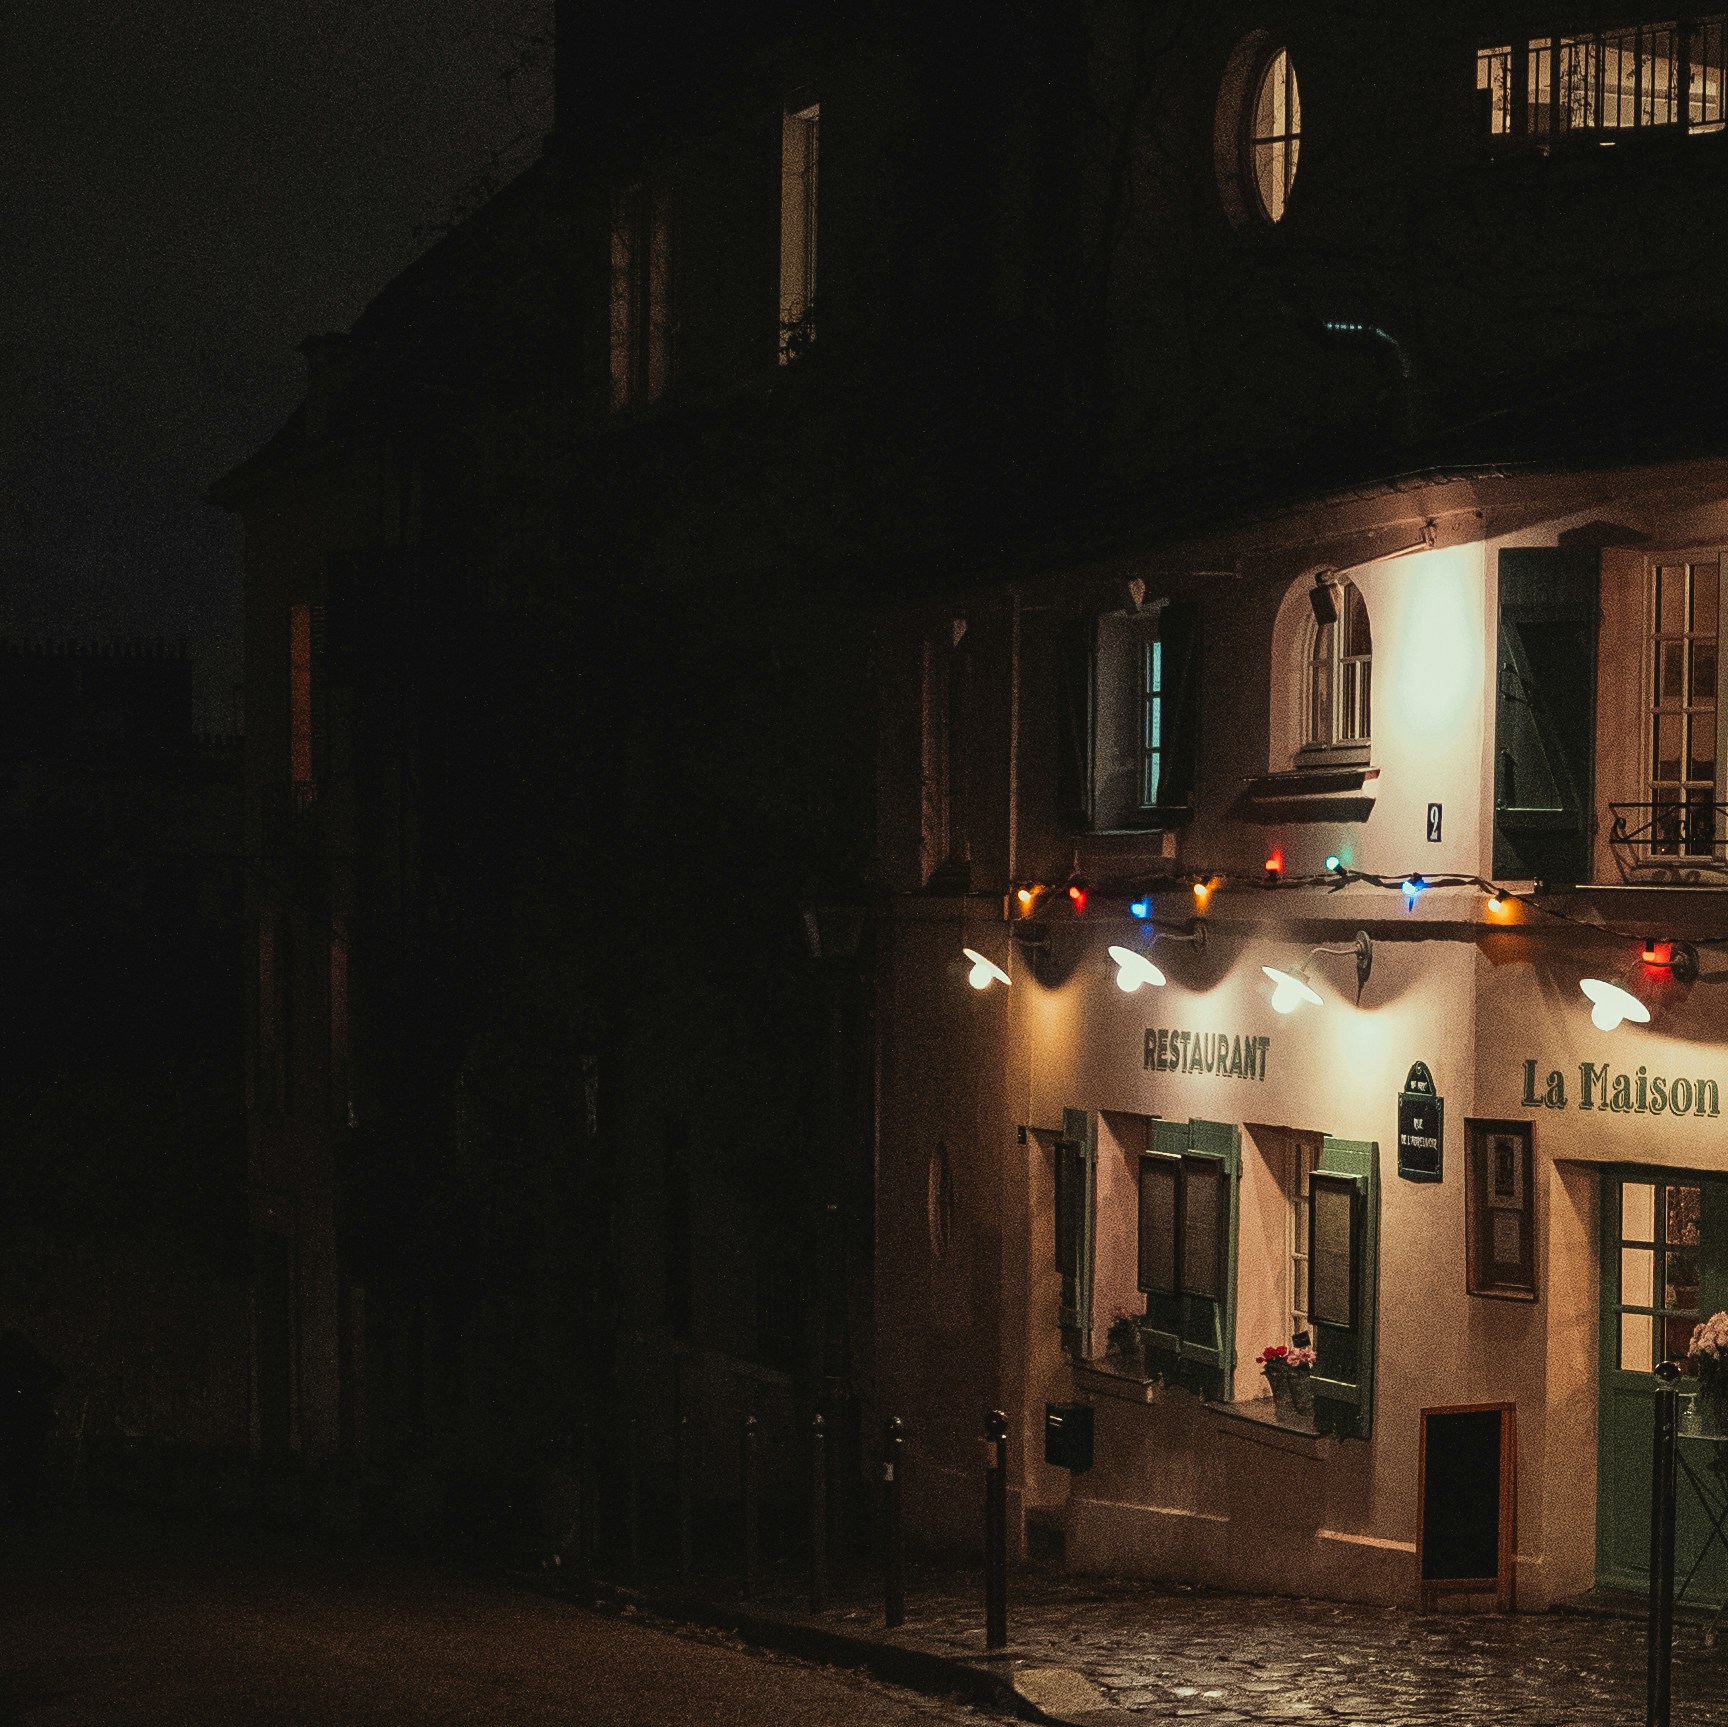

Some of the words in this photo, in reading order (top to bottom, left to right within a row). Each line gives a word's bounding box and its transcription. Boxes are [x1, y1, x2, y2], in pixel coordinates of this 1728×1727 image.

[1430, 806, 1439, 840] 2
[1143, 1028, 1270, 1081] RESTAURANT
[1521, 1059, 1568, 1108] La
[1579, 1062, 1720, 1117] Maison
